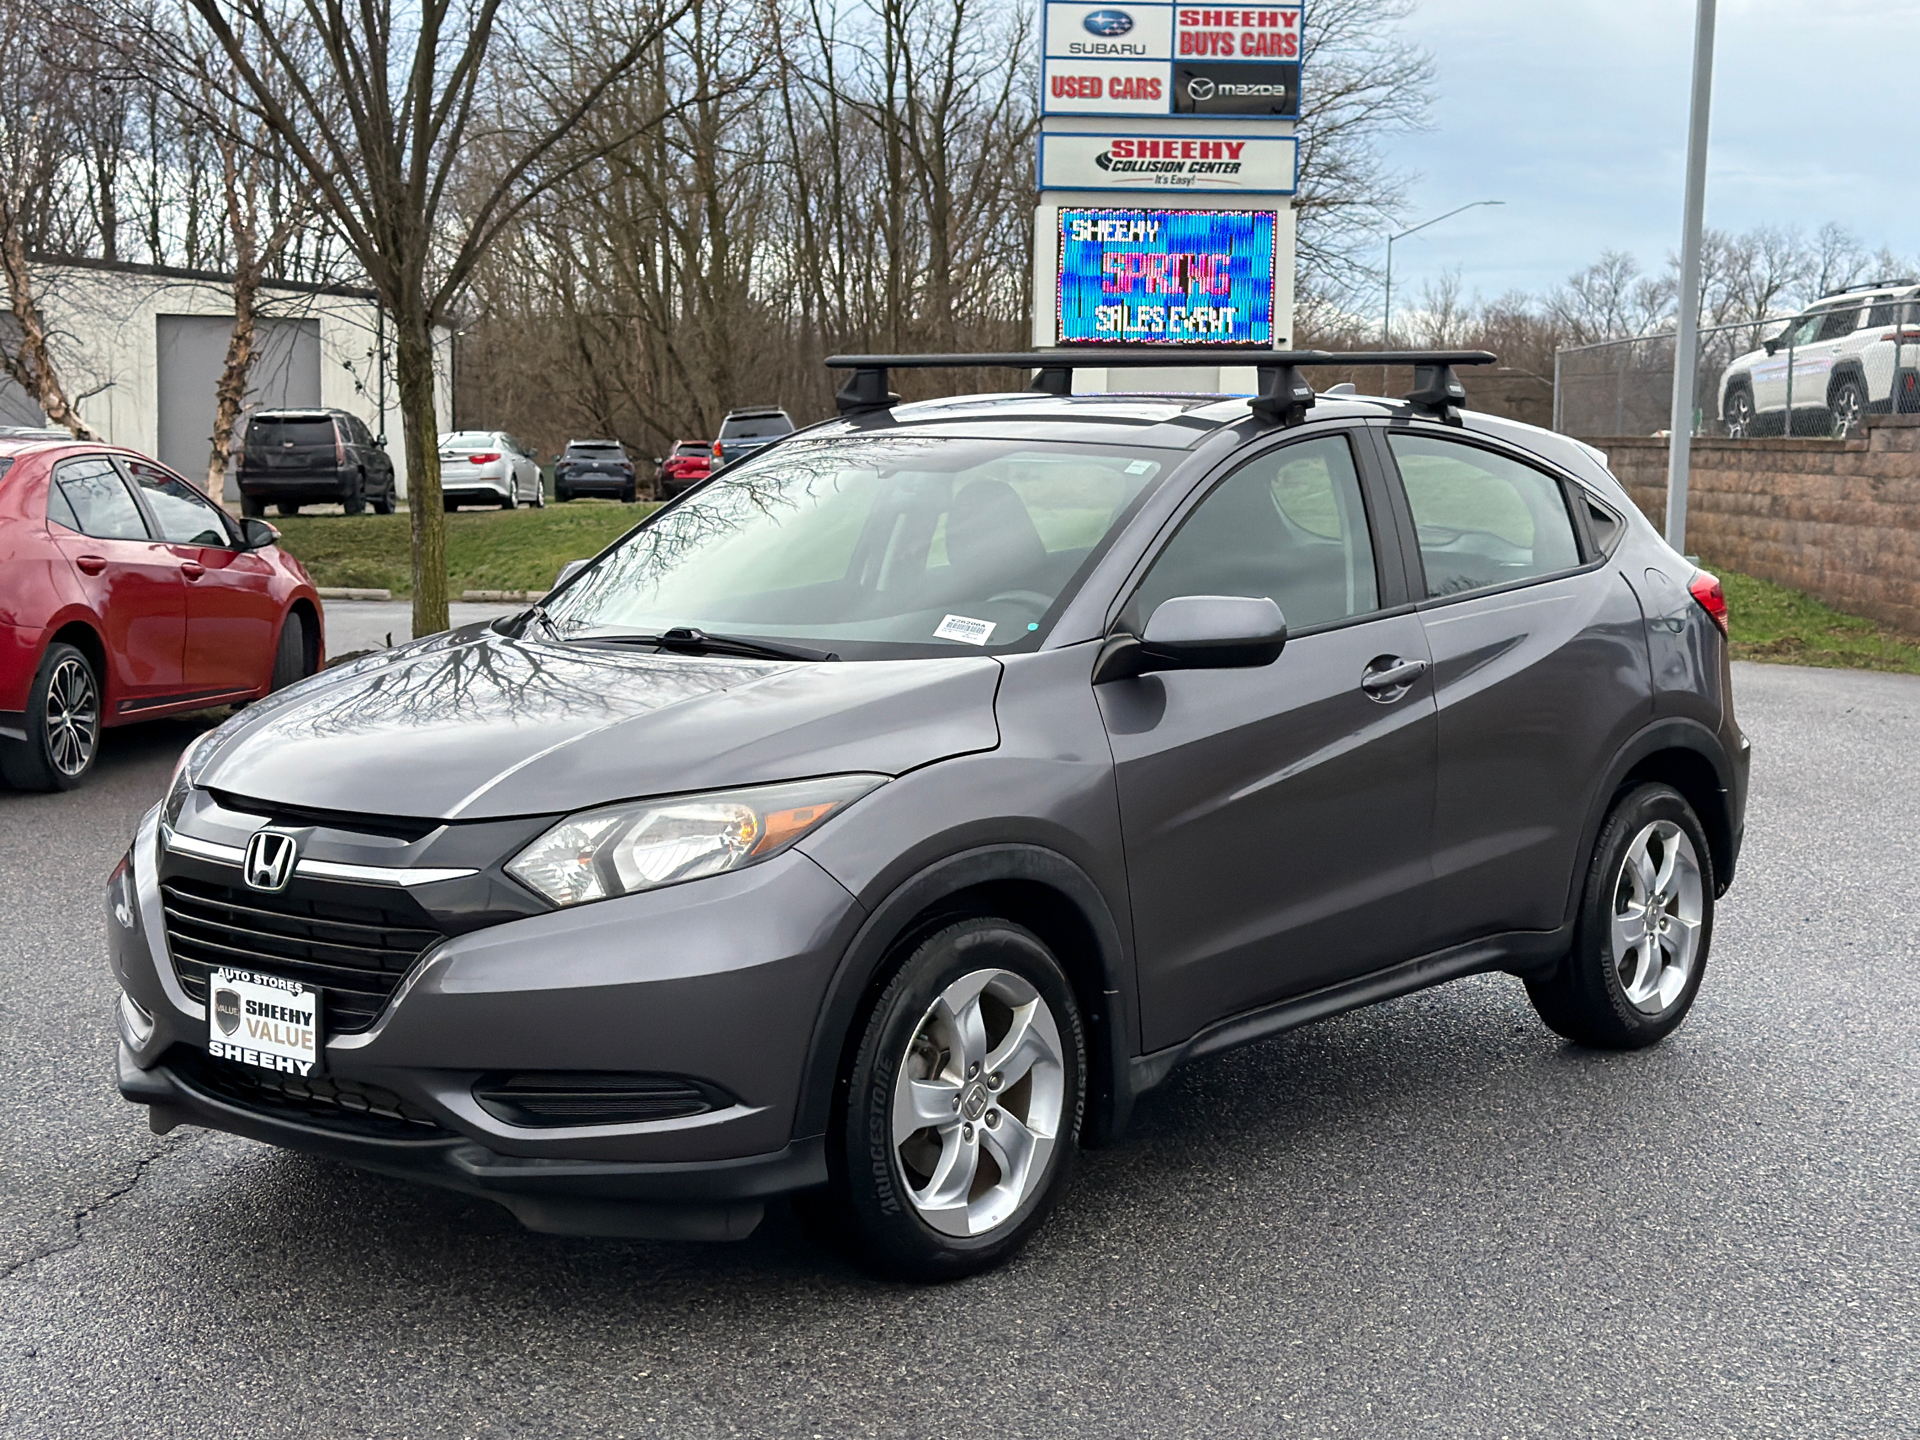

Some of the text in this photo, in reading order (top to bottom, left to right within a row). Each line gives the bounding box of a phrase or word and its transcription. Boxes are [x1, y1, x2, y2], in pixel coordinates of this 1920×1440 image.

[1179, 10, 1298, 27] SHEEHY
[1069, 43, 1146, 55] SUBARU
[1179, 31, 1298, 57] BUYS CARS
[1052, 76, 1162, 100] USED CARS
[1111, 140, 1245, 160] SHEEHY
[1111, 160, 1242, 174] COLLISION CENTER
[1155, 175, 1196, 187] It's Easy!
[1072, 219, 1160, 243] SHEEHY
[1102, 252, 1231, 295] SPRING
[1095, 304, 1165, 333] SALES
[217, 967, 304, 993] AUTO STORES
[216, 1004, 239, 1016] VALUE
[245, 999, 313, 1027] SHEEHY
[245, 1017, 314, 1051] VALUE
[208, 1040, 314, 1077] SHEEHY
